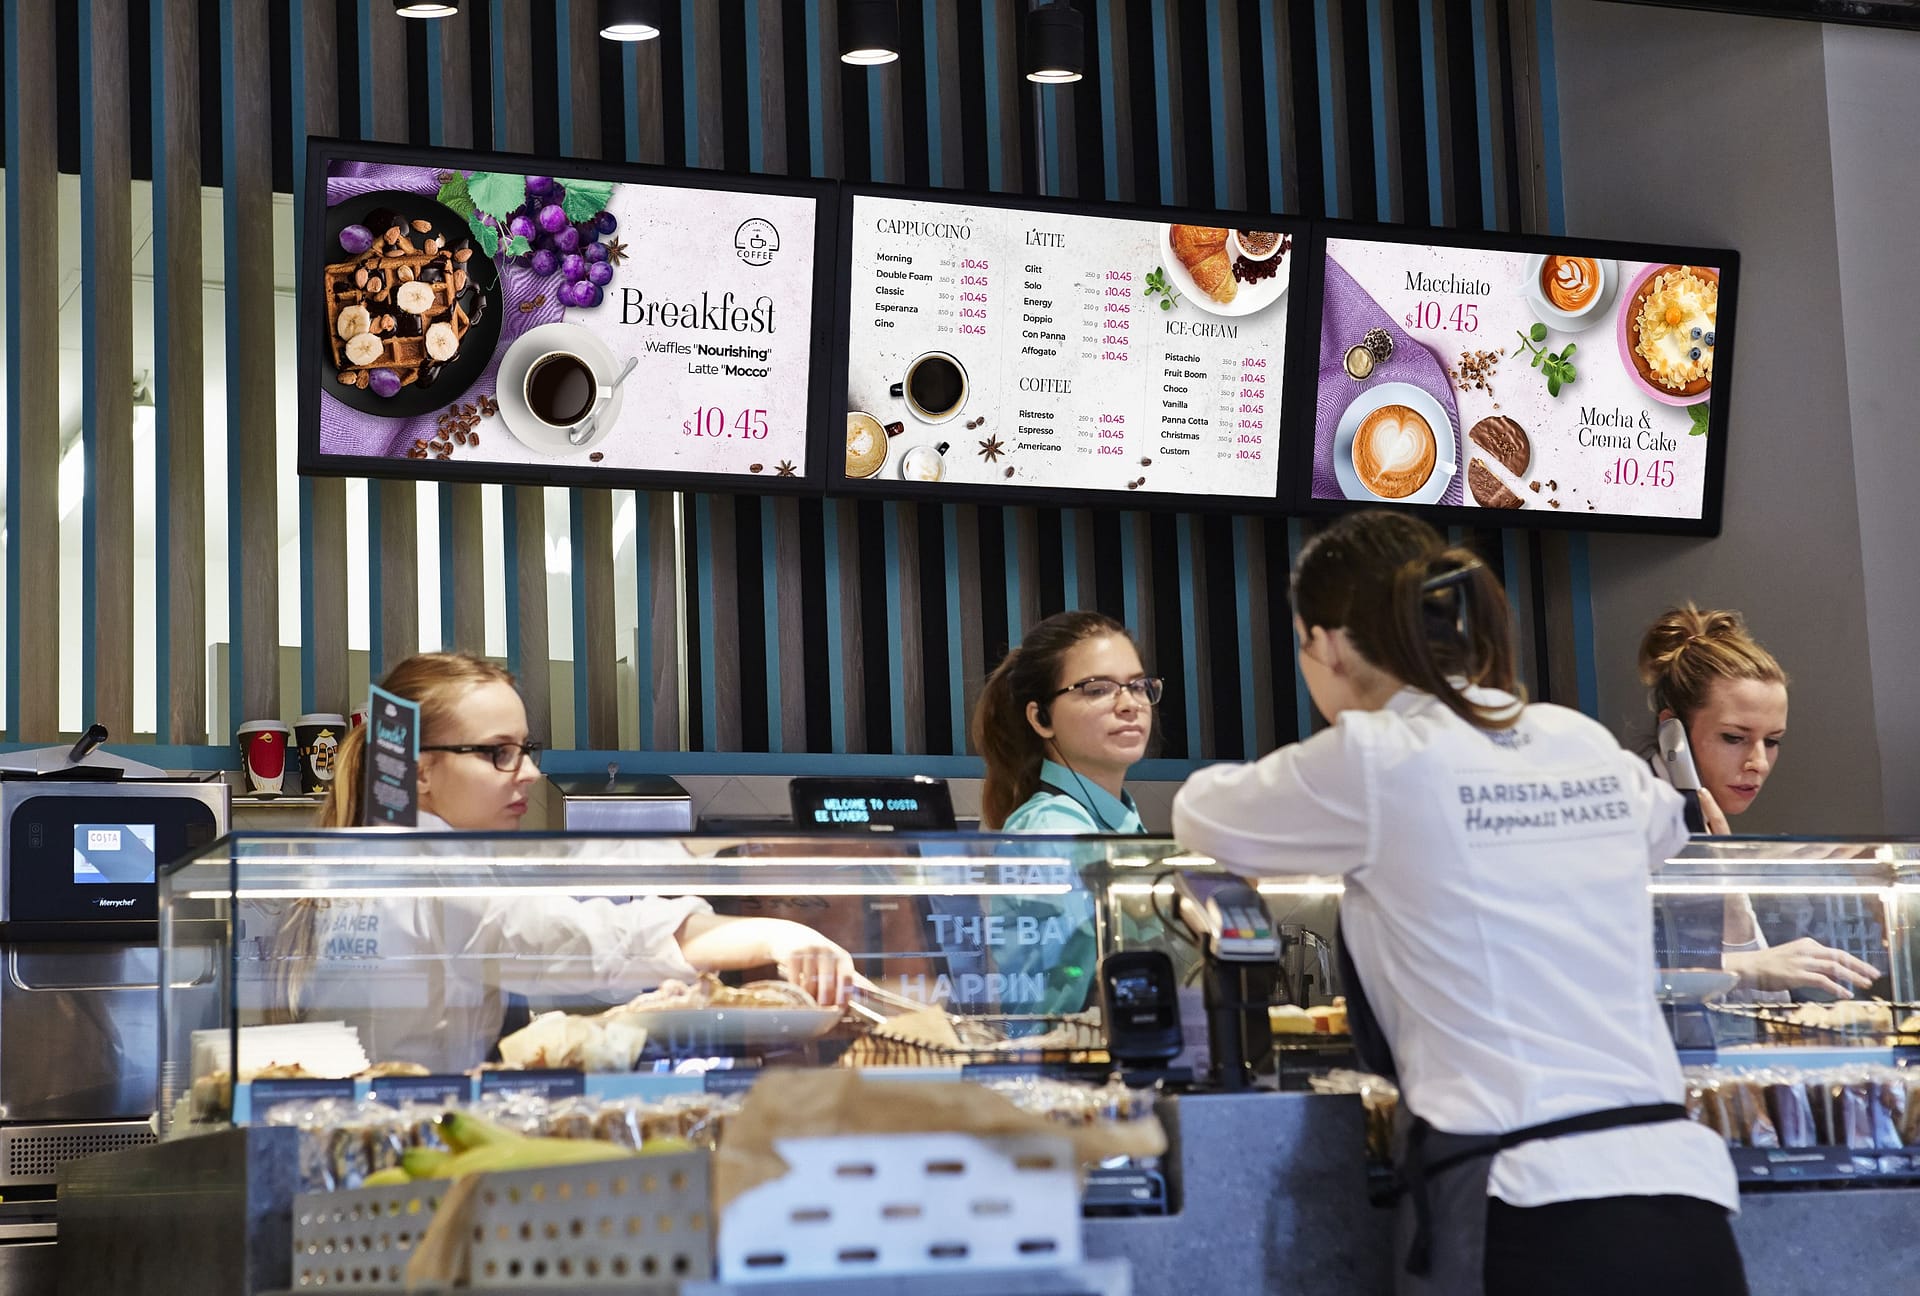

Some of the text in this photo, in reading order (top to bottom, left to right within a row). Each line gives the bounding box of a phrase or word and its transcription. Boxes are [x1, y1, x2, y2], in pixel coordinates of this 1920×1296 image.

[737, 250, 773, 260] COFFEE
[876, 253, 912, 265] Morning
[961, 259, 989, 270] $10.45
[876, 270, 907, 280] Double
[909, 272, 933, 281] Foam
[960, 276, 988, 286] $10.45
[1025, 265, 1042, 273] Glitt
[1106, 271, 1132, 281] $10.45
[1024, 281, 1042, 290] Solo
[1105, 287, 1131, 297] $10.45
[1404, 271, 1490, 296] Macchiato
[875, 286, 904, 296] Classic
[960, 292, 987, 302] $10.45
[619, 287, 777, 334] Breakfest
[875, 303, 918, 313] Esperanza
[959, 308, 986, 318] $10.45
[1024, 298, 1052, 308] Energy
[1104, 303, 1130, 313] $10.45
[1023, 314, 1053, 324] Doppio
[1103, 319, 1129, 329] $10.45
[1405, 300, 1478, 332] $10.45
[874, 319, 895, 328] Gino
[959, 325, 986, 334] $10.45
[1166, 320, 1238, 338] ICE-CREAM
[1022, 330, 1038, 338] Con
[1040, 331, 1066, 340] Panna
[1102, 335, 1128, 345] $10.45
[645, 340, 772, 361] Waffles "Nourishing"
[1021, 346, 1056, 356] Affogato
[1101, 351, 1128, 361] $10.45
[1165, 353, 1200, 362] Pistachio
[1242, 358, 1266, 368] $10.45
[688, 362, 772, 377] Latte "Mocco"
[1164, 369, 1182, 377] Fruit
[1184, 370, 1207, 379] Boom
[1240, 374, 1265, 383] $10.45
[1019, 377, 1071, 393] COFFEE
[1163, 384, 1188, 393] Choco
[1240, 389, 1264, 398] $10.45
[1162, 400, 1188, 409] Vanilla
[1239, 404, 1264, 414] $10.45
[683, 406, 768, 439] $10.45
[1019, 410, 1054, 419] Ristresto
[1099, 414, 1125, 423] $10.45
[1162, 416, 1186, 424] Panna
[1188, 417, 1208, 426] Cotta
[1238, 420, 1263, 429] $10.45
[1579, 407, 1651, 429] Mocha &
[1018, 426, 1054, 435] Espresso
[1098, 430, 1124, 439] $10.45
[1161, 431, 1200, 440] Christmas
[1237, 435, 1262, 444] $10.45
[1578, 427, 1677, 452] Crema Cake
[1017, 442, 1061, 451] Americano
[1097, 446, 1123, 455] $10.45
[1160, 446, 1190, 456] Custom
[1236, 450, 1261, 460] $10.45
[1604, 457, 1674, 487] $10.45
[1458, 776, 1621, 804] BARISTA, BAKER
[823, 798, 918, 811] WELCOME TO COSTA
[832, 810, 869, 822] LOVERS
[1561, 801, 1632, 824] MAKER
[90, 833, 117, 842] COSTA
[100, 899, 134, 907] Merrychef
[926, 914, 1006, 945] THE
[325, 939, 377, 954] MAKER
